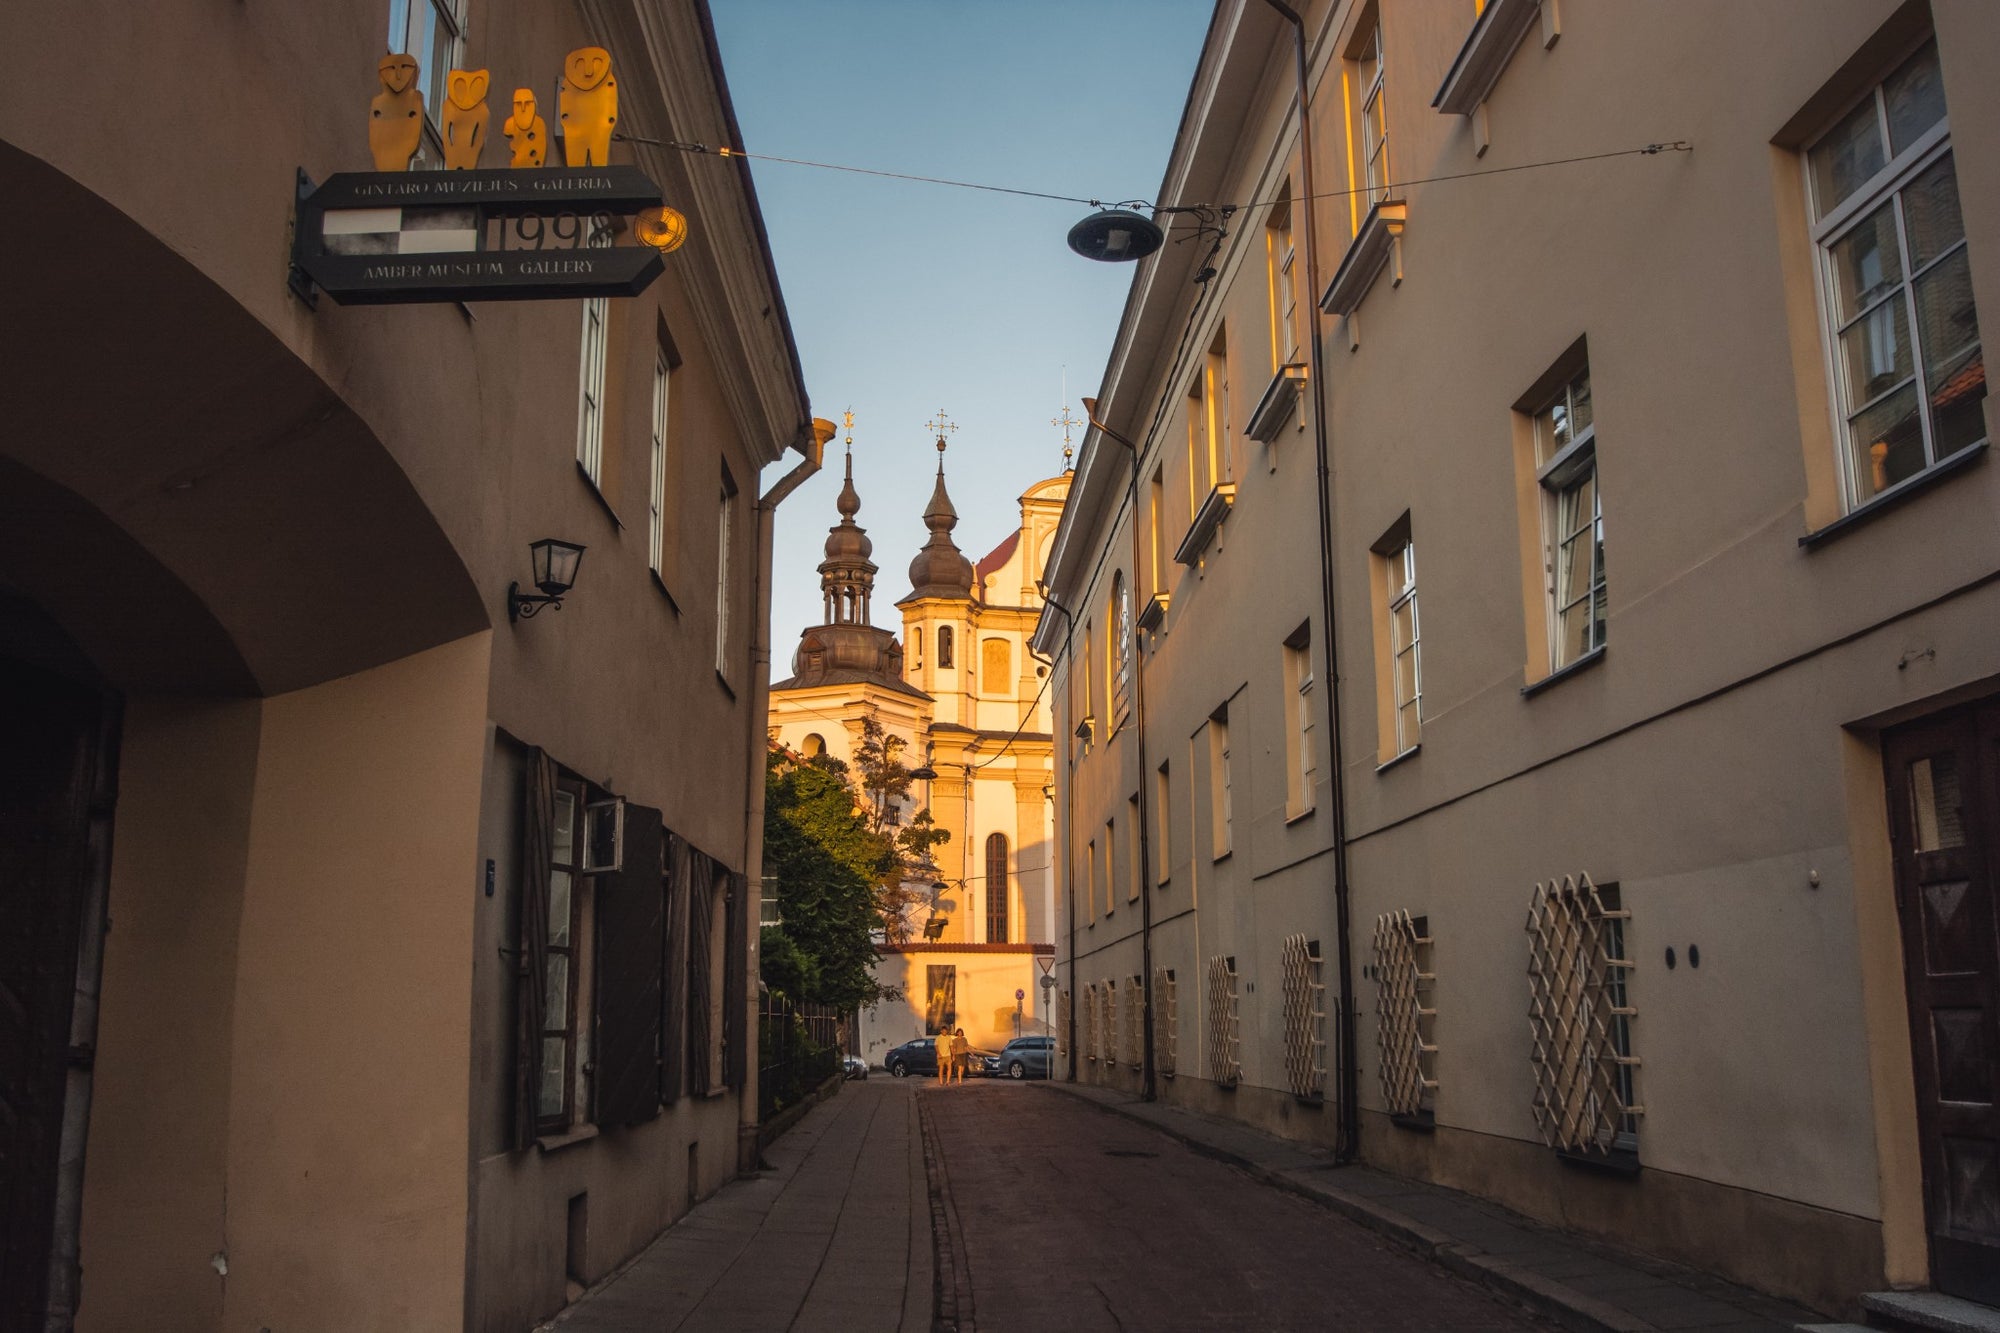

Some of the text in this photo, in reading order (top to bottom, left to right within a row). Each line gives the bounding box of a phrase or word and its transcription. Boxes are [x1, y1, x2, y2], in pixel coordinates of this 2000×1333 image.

[354, 177, 613, 196] GINTARO MUZIEJUS GALERIJA
[496, 211, 614, 250] 1998
[363, 260, 595, 280] AMBER MUSEUM GALLERY
